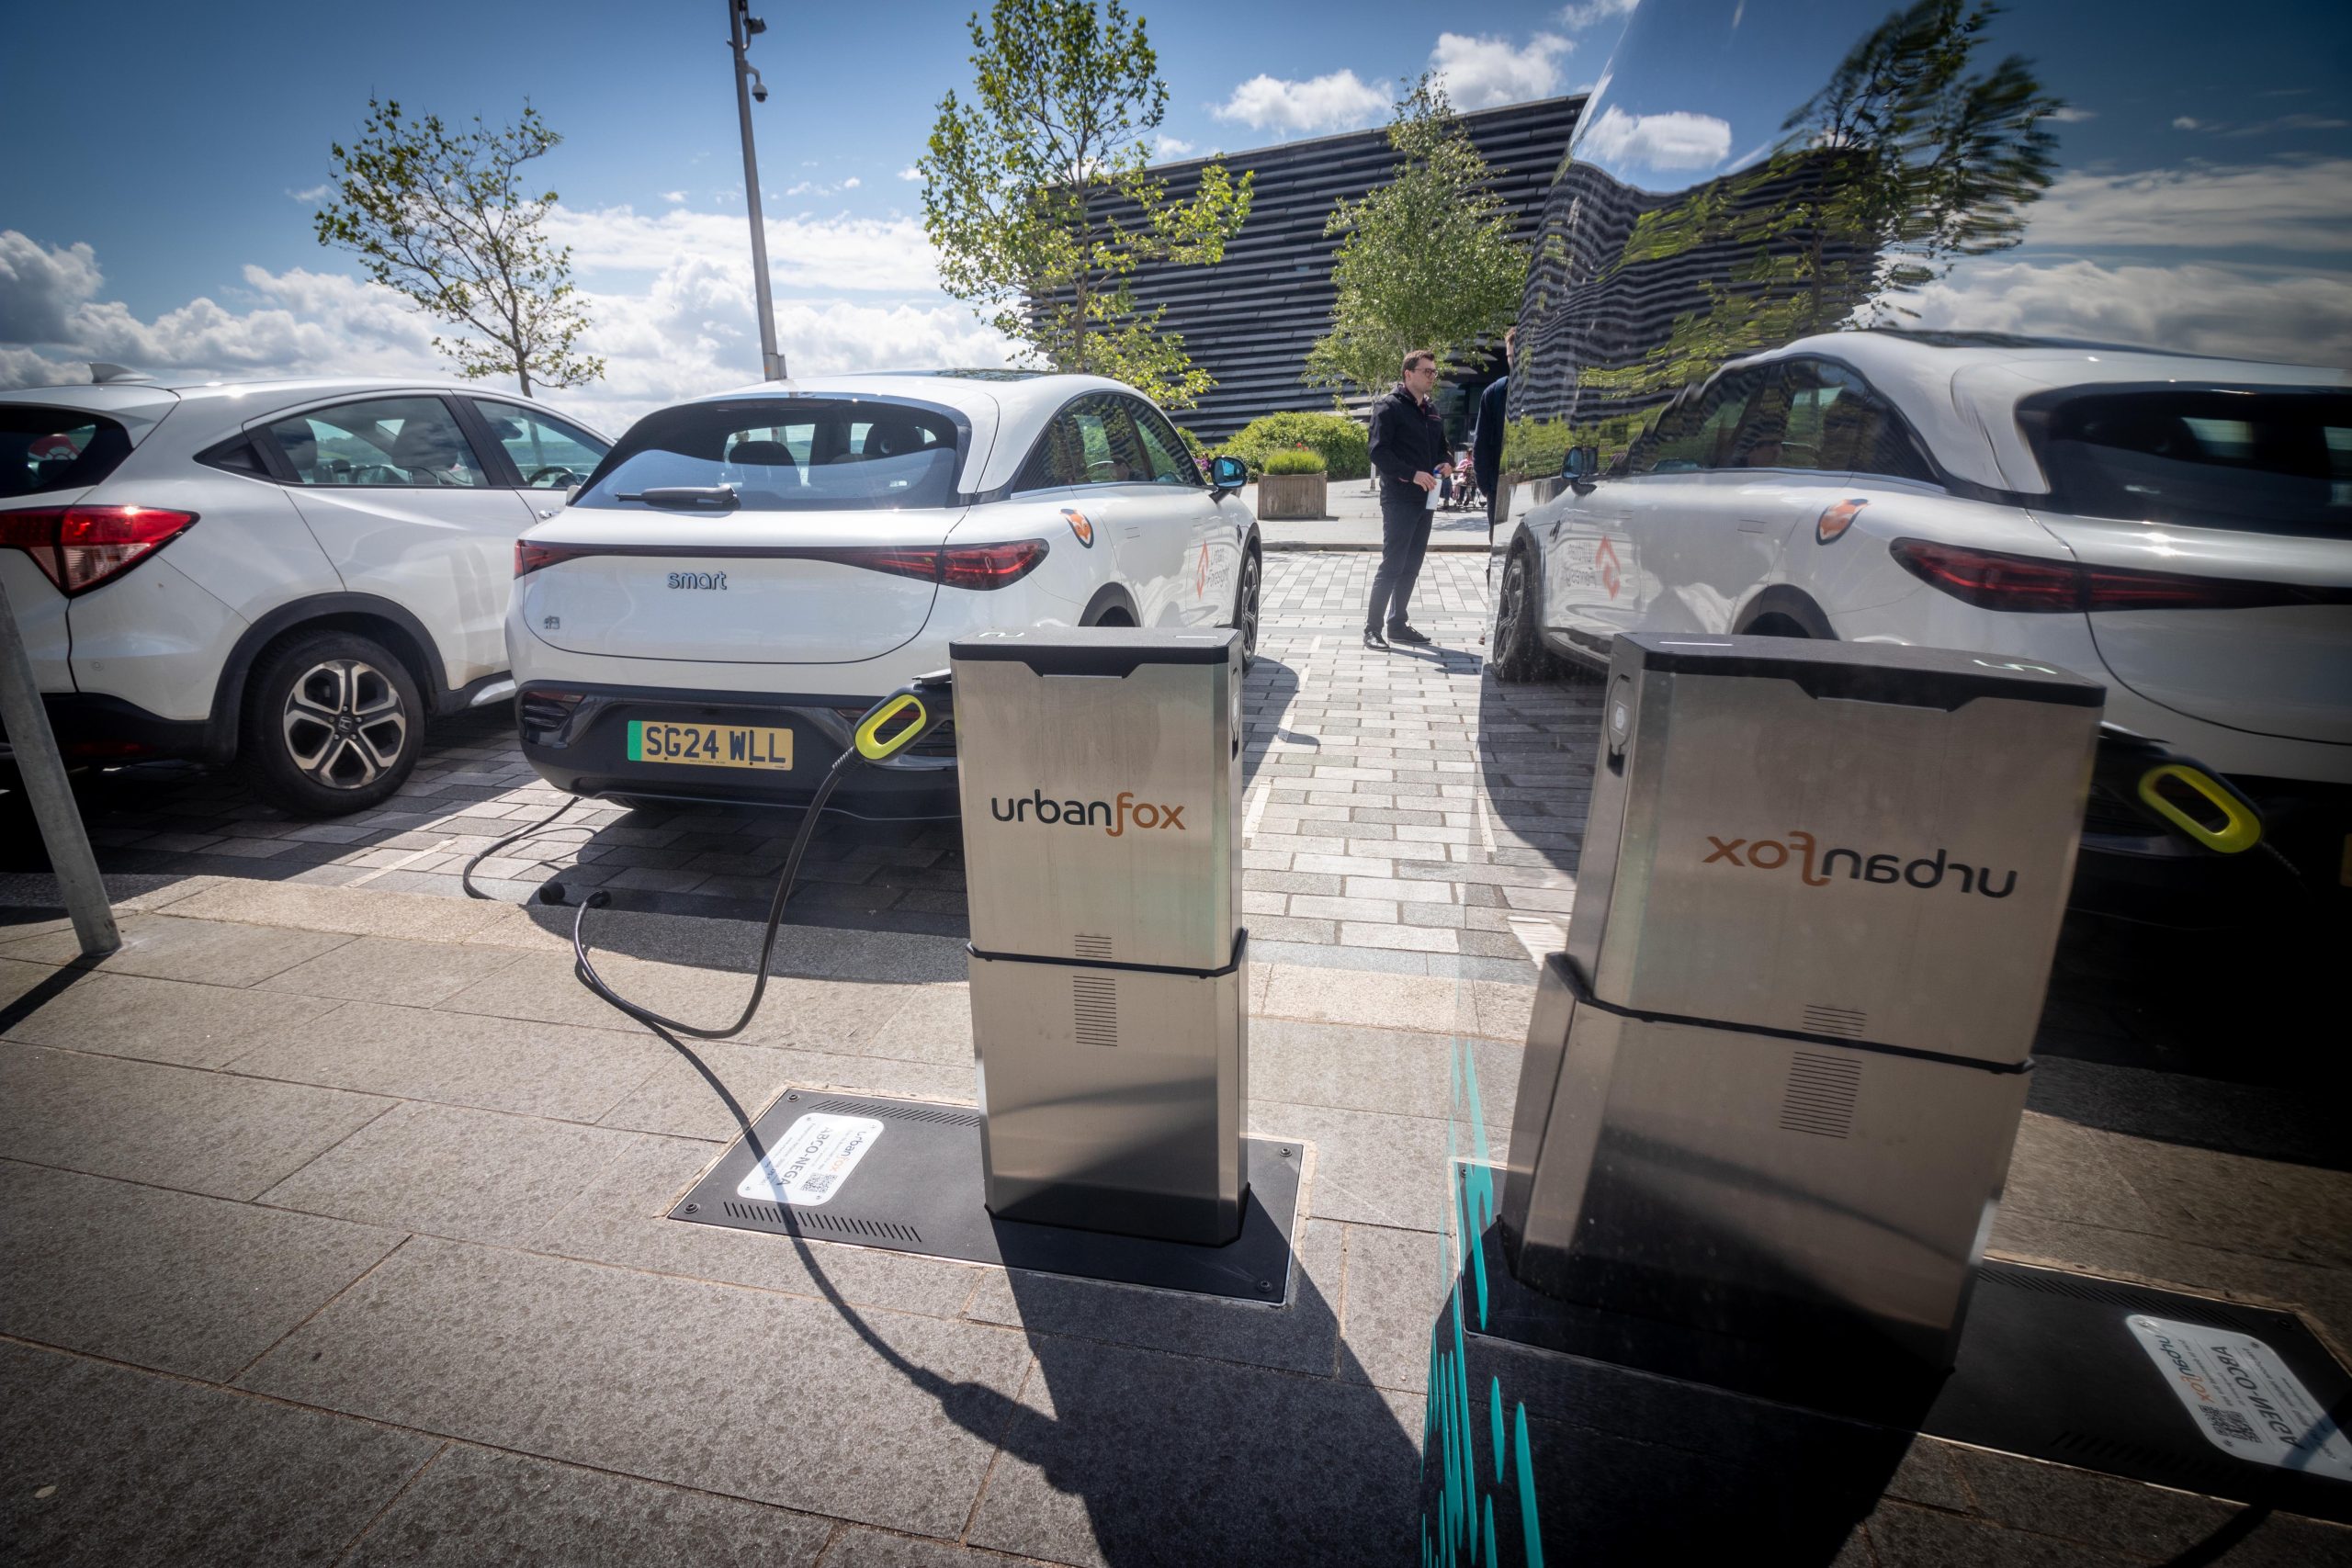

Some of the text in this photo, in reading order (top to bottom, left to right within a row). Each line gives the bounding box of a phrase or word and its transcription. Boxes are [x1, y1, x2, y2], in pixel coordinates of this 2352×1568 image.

[667, 571, 727, 590] smart
[646, 727, 786, 763] SG24 WLL
[991, 789, 1186, 838] urbanfox
[776, 1126, 834, 1187] ABCO-NEGA
